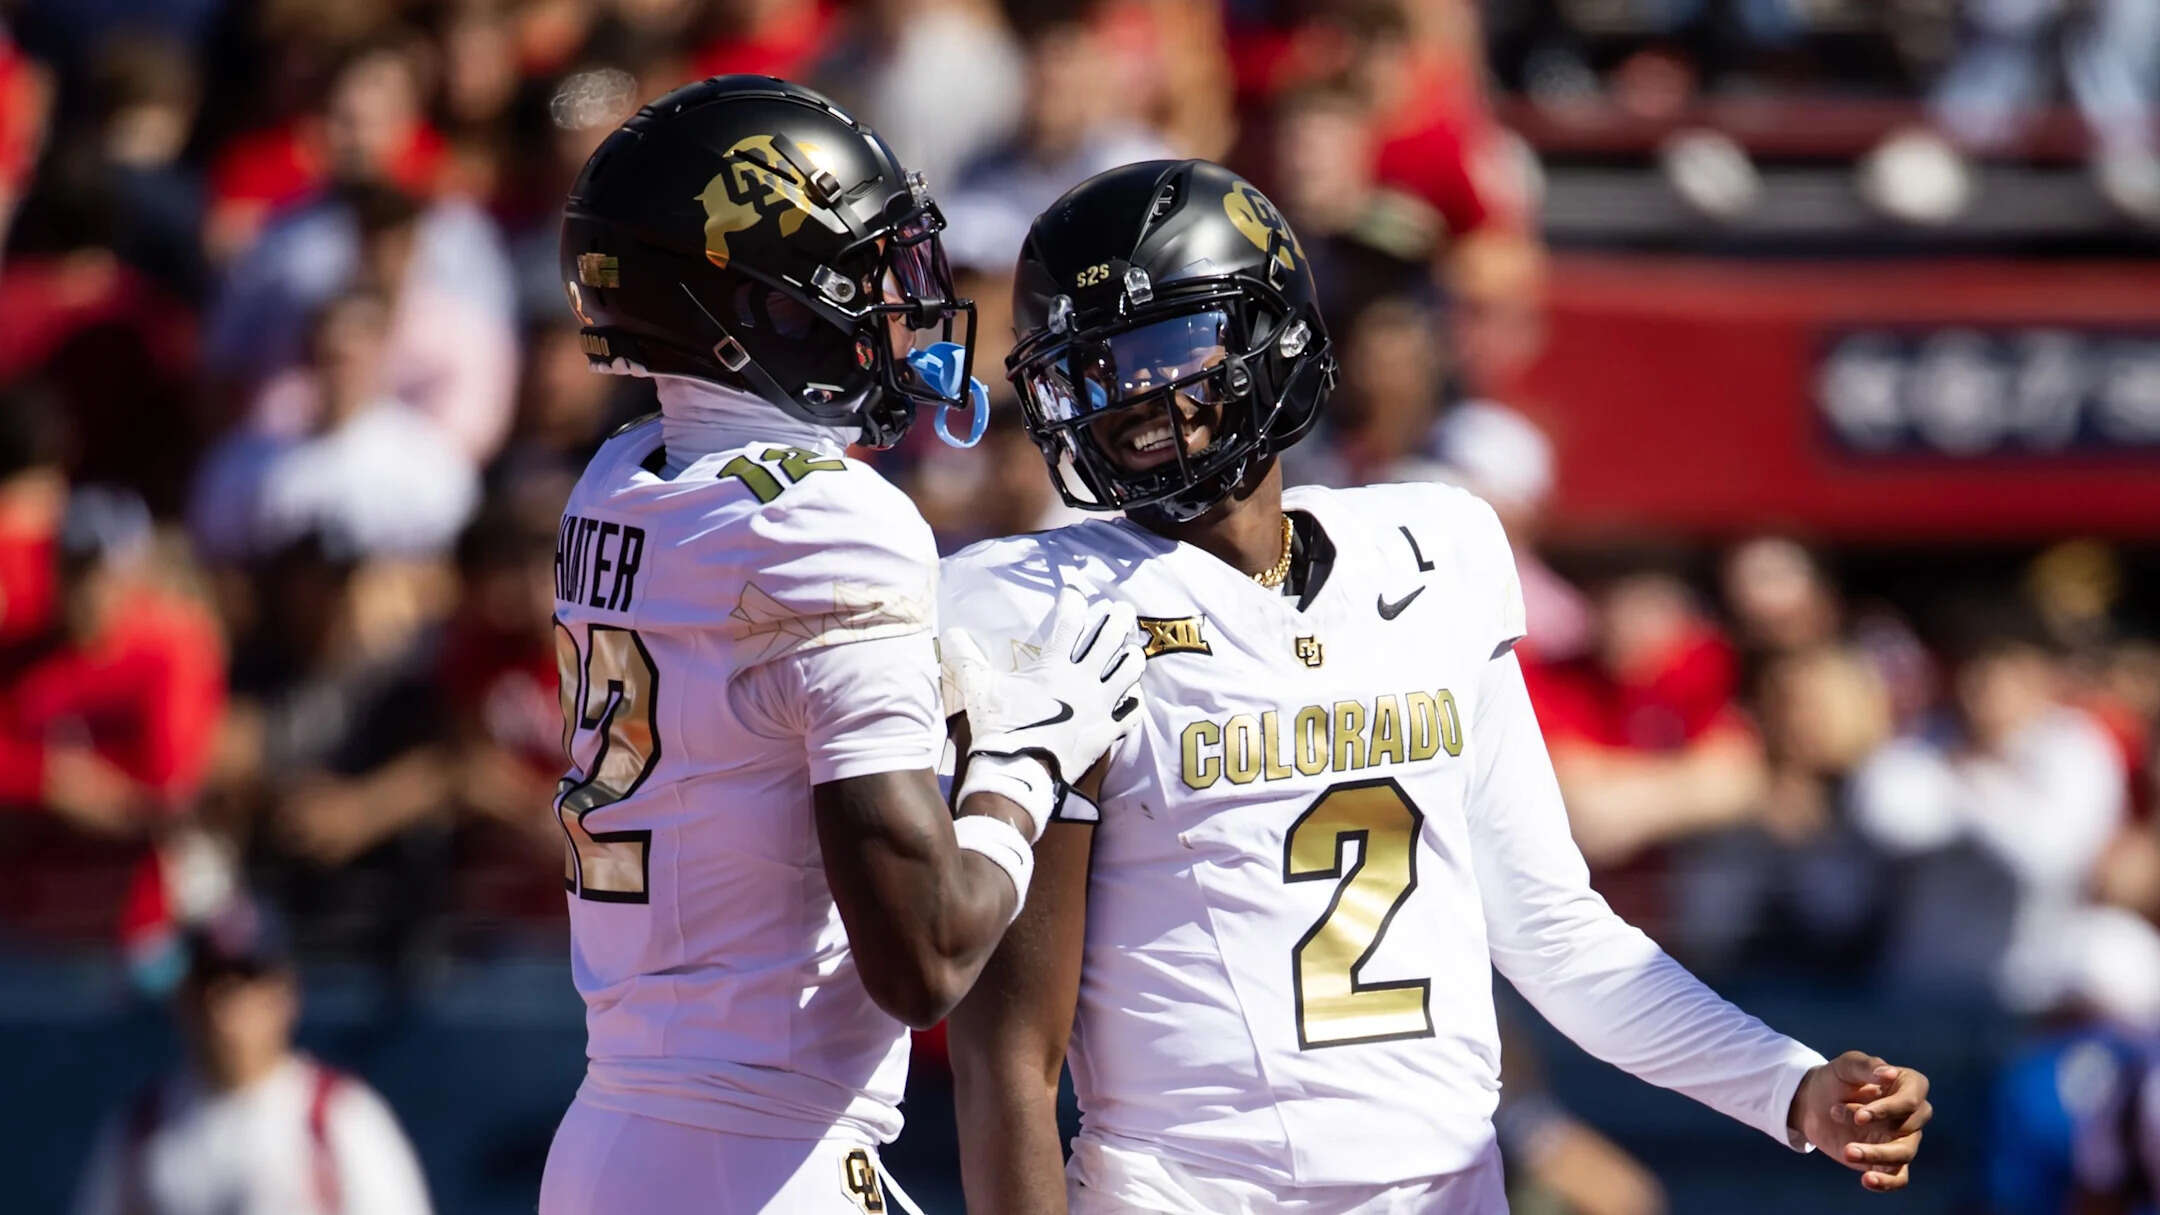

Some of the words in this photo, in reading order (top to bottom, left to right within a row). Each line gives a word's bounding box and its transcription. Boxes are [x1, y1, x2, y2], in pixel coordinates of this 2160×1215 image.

[1077, 263, 1110, 288] S2S
[716, 446, 848, 505] 12
[1181, 688, 1464, 790] COLORADO
[1283, 776, 1436, 1052] 2
